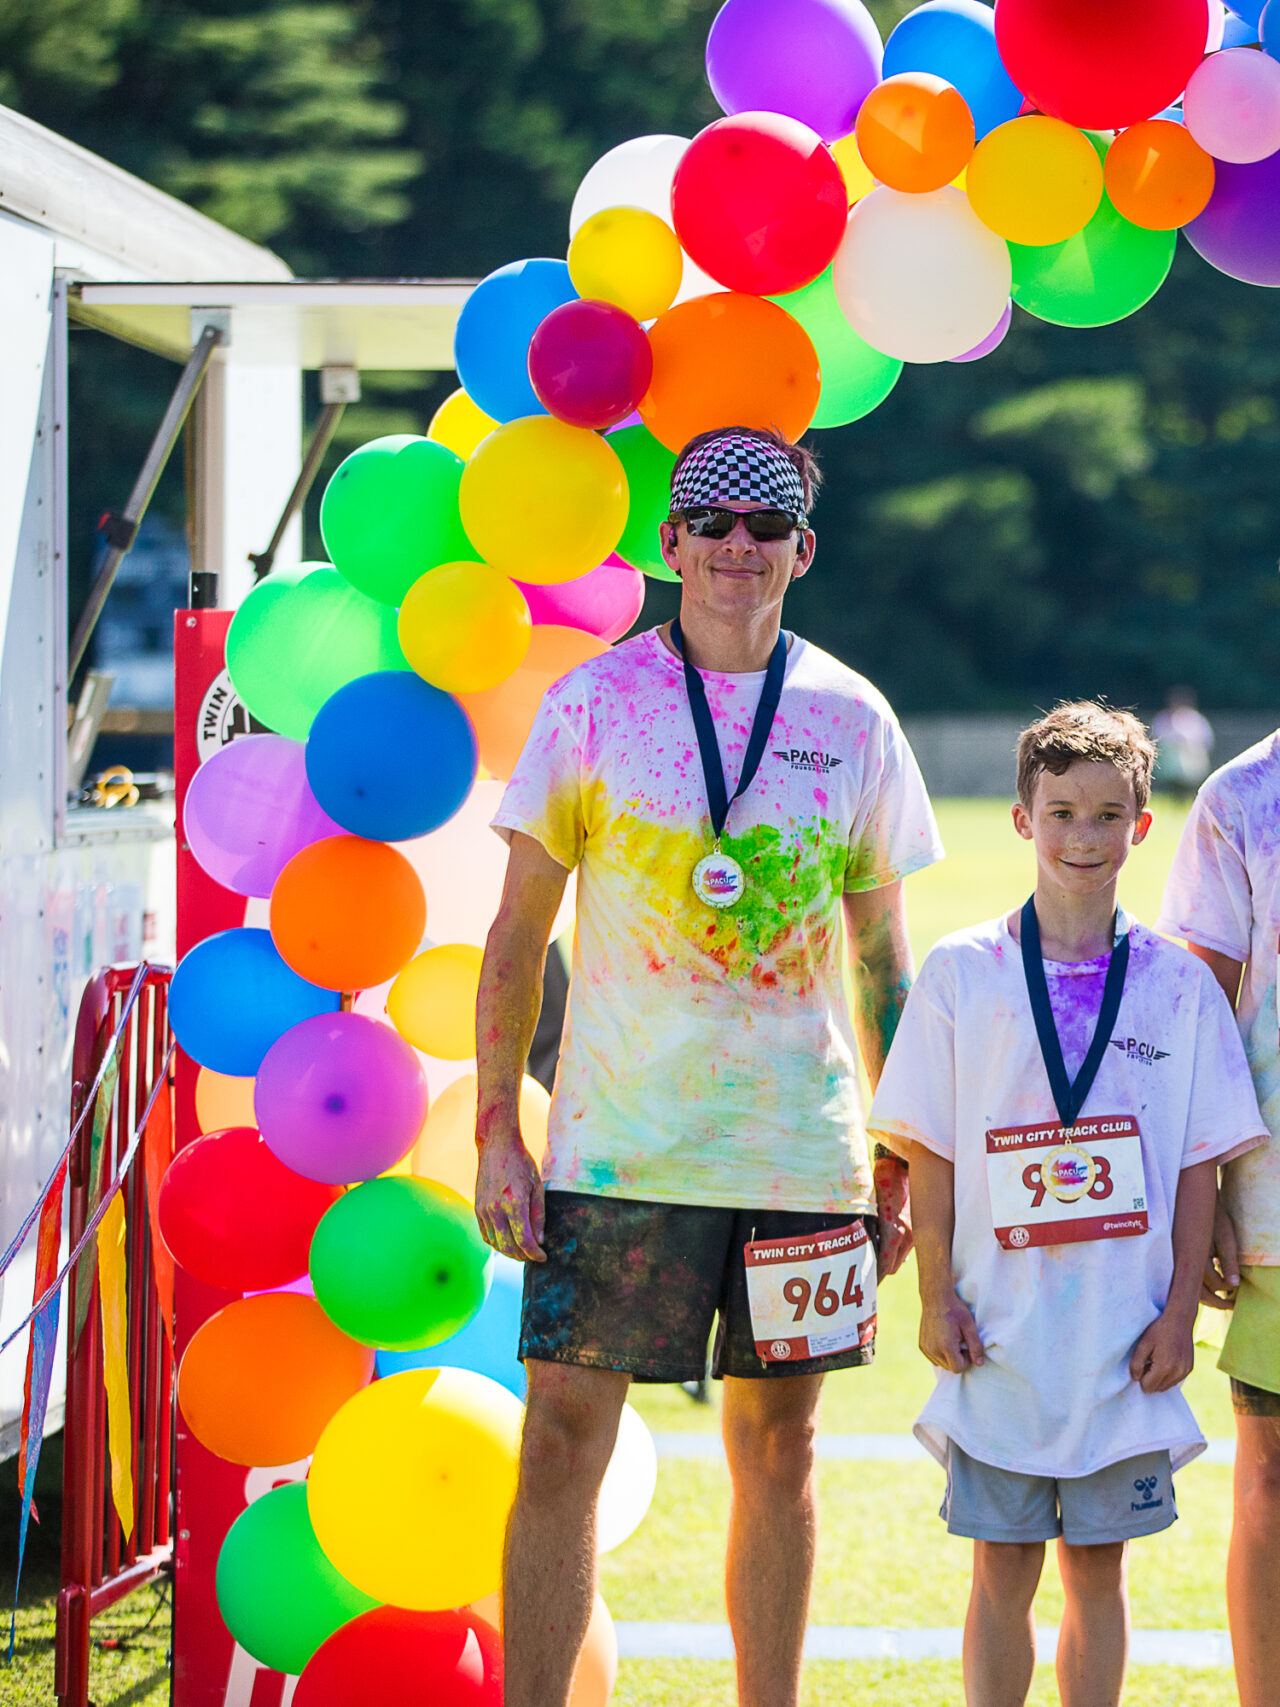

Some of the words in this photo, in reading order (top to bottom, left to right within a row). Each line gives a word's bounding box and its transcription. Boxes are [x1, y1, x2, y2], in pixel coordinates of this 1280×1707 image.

[204, 687, 228, 740] TWIN
[791, 749, 830, 766] PACU
[791, 765, 830, 773] FOUNDAON
[1127, 1038, 1155, 1058] PCU
[993, 1133, 1023, 1147] TWIN
[1026, 1129, 1055, 1143] CITY
[1058, 1124, 1098, 1138] TRACK
[1101, 1121, 1132, 1133] CLUB
[1022, 1155, 1114, 1208] 98
[1058, 1167, 1079, 1176] PACU
[753, 1248, 784, 1260] TWIN
[787, 1244, 816, 1256] CITY
[817, 1235, 852, 1252] TRACK
[783, 1264, 864, 1322] 964
